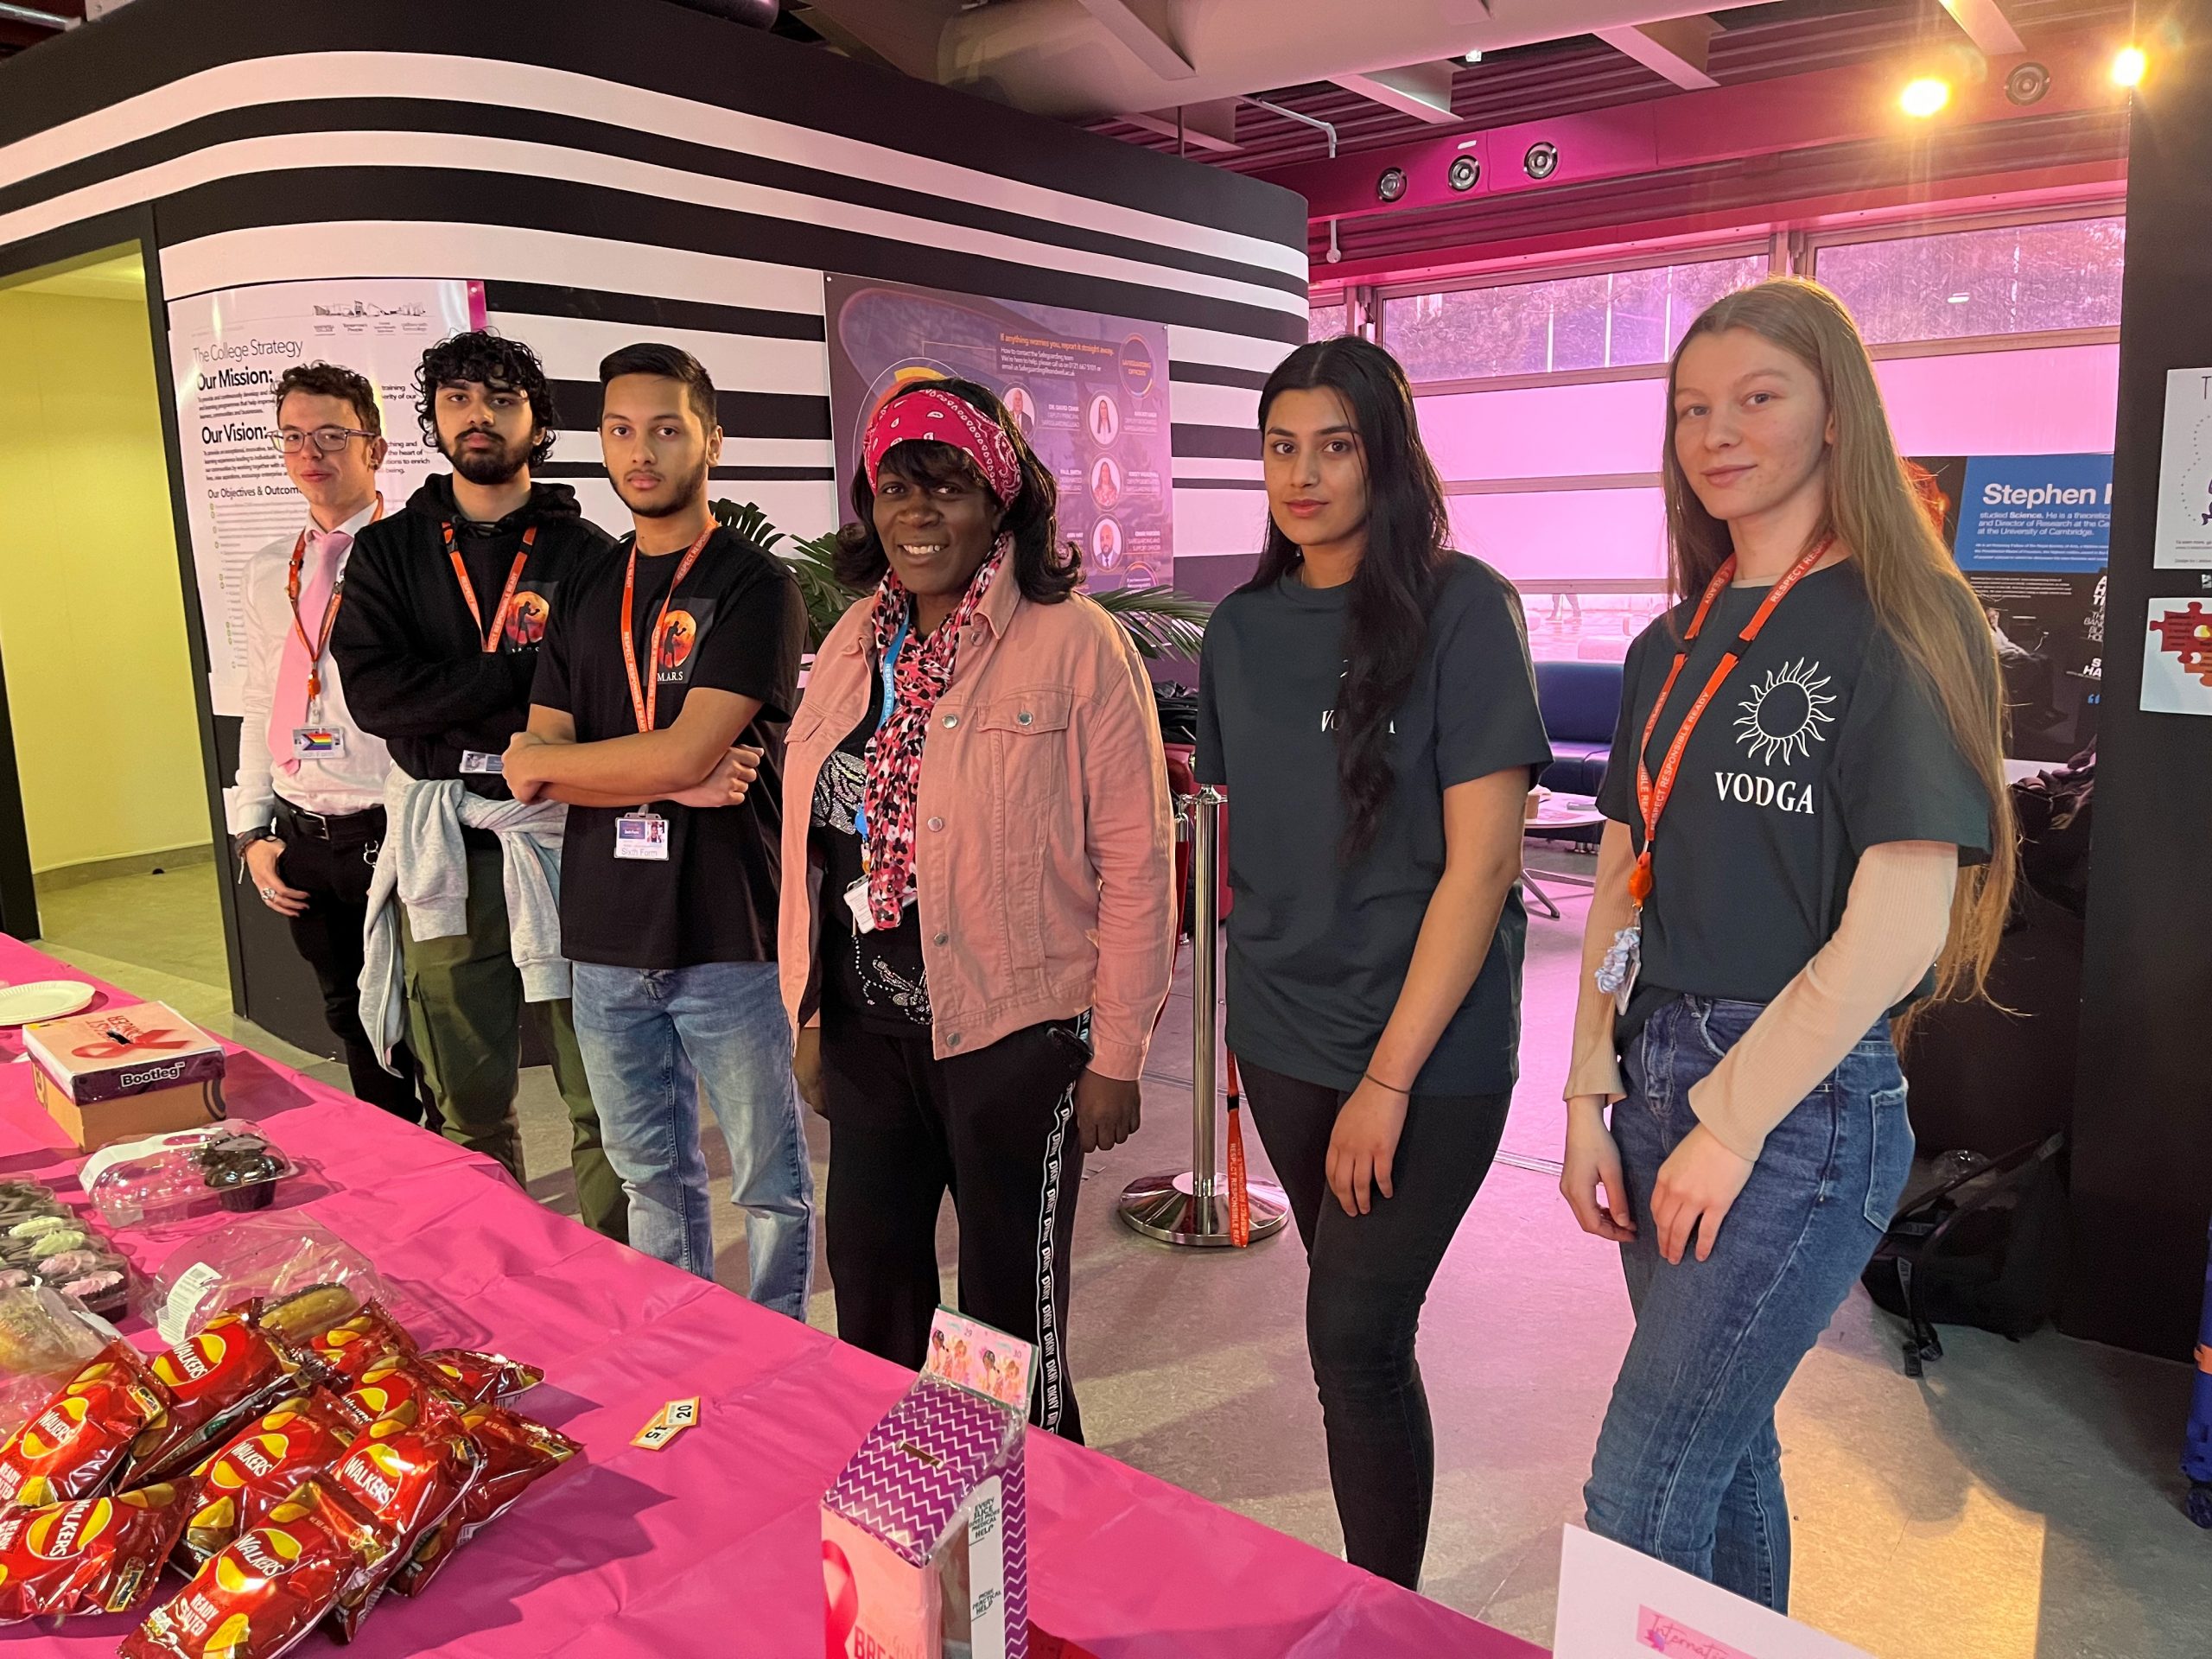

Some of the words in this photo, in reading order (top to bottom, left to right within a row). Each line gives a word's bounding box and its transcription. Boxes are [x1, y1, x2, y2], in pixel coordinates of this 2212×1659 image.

[194, 347, 210, 362] The
[210, 342, 249, 362] College
[251, 339, 303, 358] Strategy
[197, 372, 217, 391] Our
[219, 365, 274, 388] Mission:
[202, 426, 222, 445] Our
[224, 422, 268, 442] Vision:
[207, 489, 219, 499] Our
[220, 487, 256, 500] Objectives
[257, 486, 264, 496] &
[1982, 483, 2096, 509] Stephen
[2000, 528, 2038, 537] University
[2049, 528, 2094, 537] Cambridge.
[506, 572, 518, 594] READY
[1770, 563, 1805, 603] RESPECT
[2083, 617, 2104, 627] BAN
[628, 663, 643, 710] RESPONSIBLE
[1649, 786, 1667, 831] RESPECT
[1659, 724, 1691, 789] RESPONSIBLE
[1688, 692, 1710, 723] READY
[1714, 772, 1815, 815] VODGA
[121, 1067, 180, 1087] Bootleg
[1230, 1178, 1240, 1229] RESPONSIBLE
[1041, 1304, 1052, 1330] DKNY
[1044, 1332, 1055, 1357] DKNY
[173, 1342, 208, 1379] WALKERS
[1046, 1383, 1058, 1411] DKNY
[676, 1405, 693, 1419] 20
[38, 1409, 73, 1446] WALKERS
[230, 1440, 273, 1478] WALKERS
[344, 1457, 395, 1507] WALKERS
[975, 1497, 995, 1512] EVERY
[971, 1516, 997, 1532] MEDICAL
[975, 1523, 994, 1539] HELP
[234, 1534, 285, 1577] WALKERS
[189, 1592, 219, 1623] READY
[972, 1590, 1001, 1611] PRACTICAL
[976, 1600, 994, 1616] HELP
[179, 1604, 208, 1637] SALTED
[854, 1624, 896, 1659] BRE
